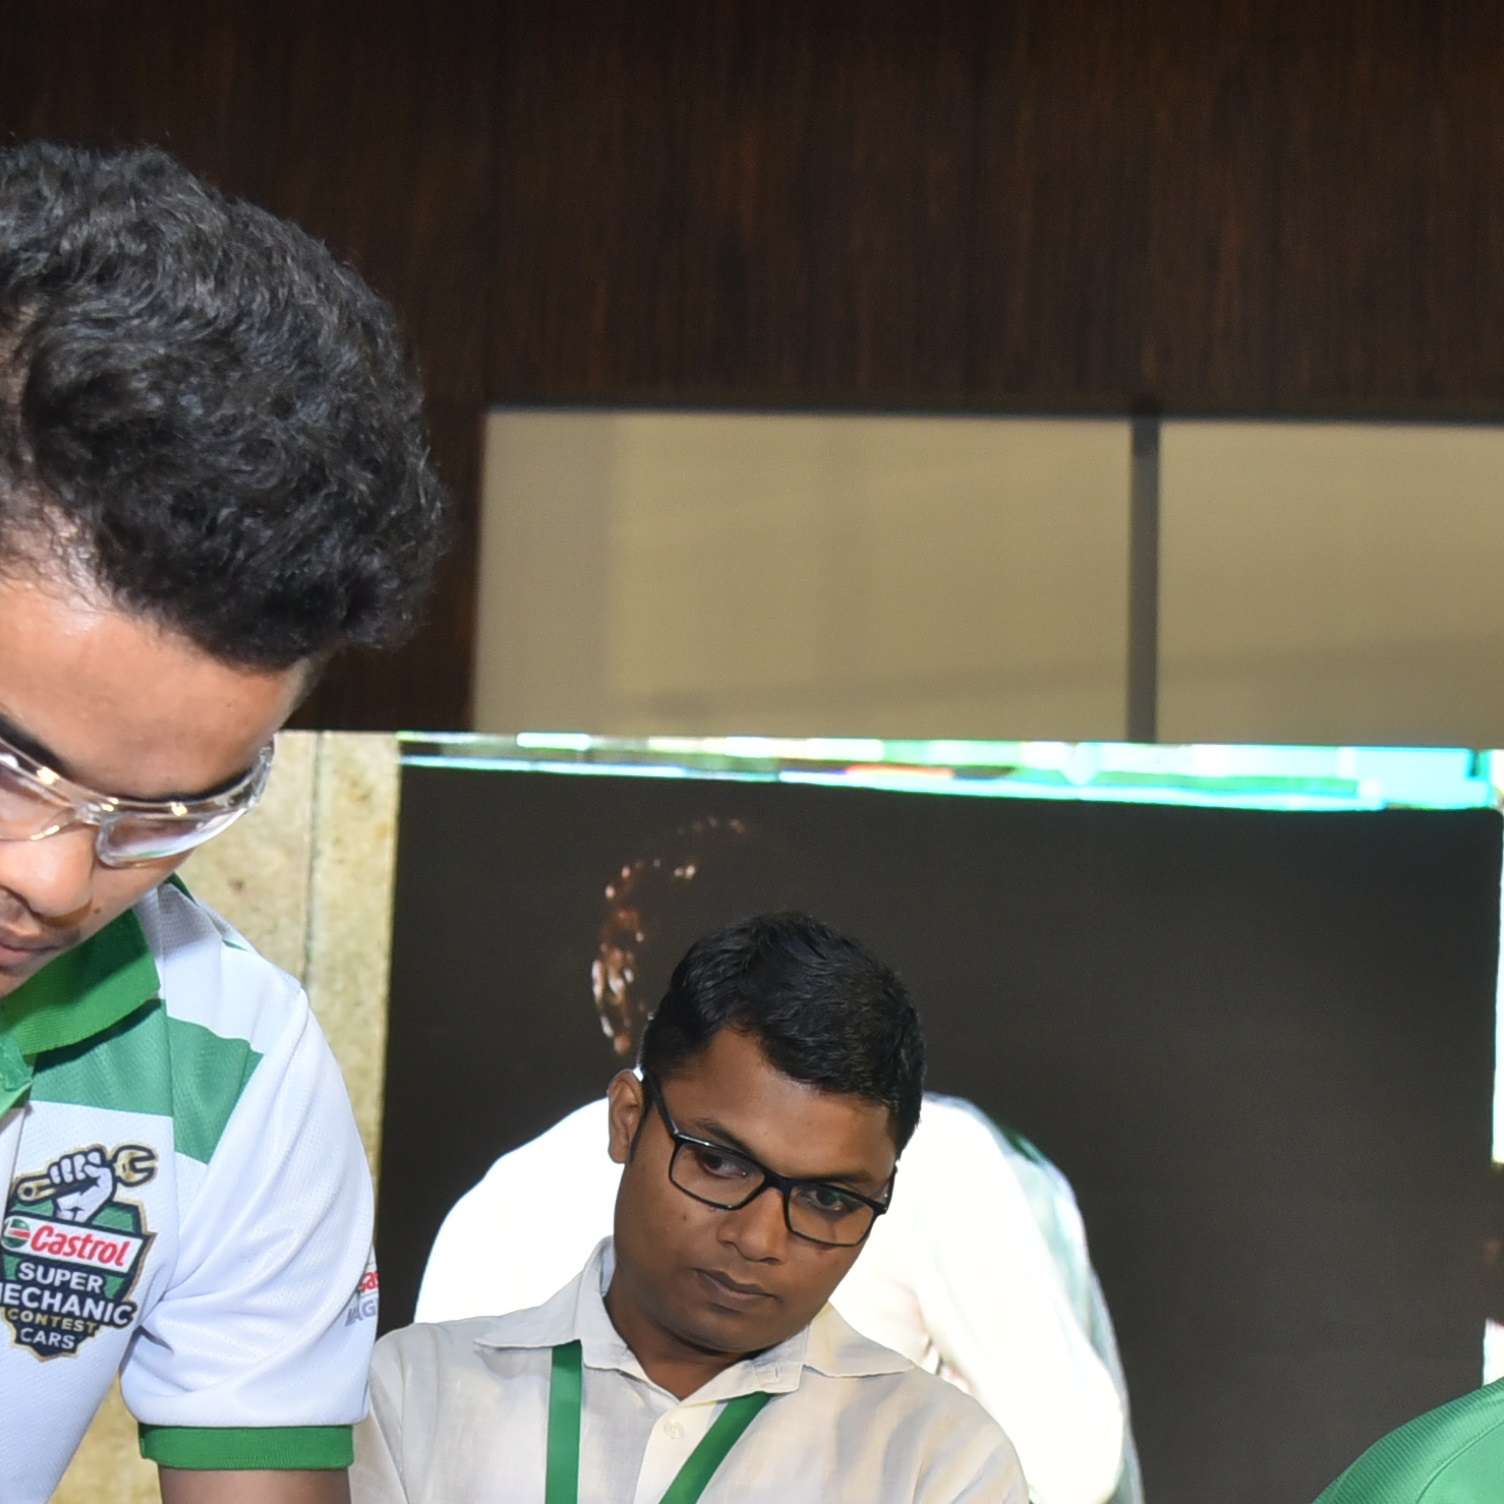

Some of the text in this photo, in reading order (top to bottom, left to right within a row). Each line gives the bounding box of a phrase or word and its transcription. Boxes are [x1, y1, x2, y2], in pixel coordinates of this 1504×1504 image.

[31, 1225, 130, 1267] Castrol
[18, 1262, 104, 1293] SUPER
[7, 1308, 97, 1334] CONTEST
[20, 1327, 76, 1350] CARS
